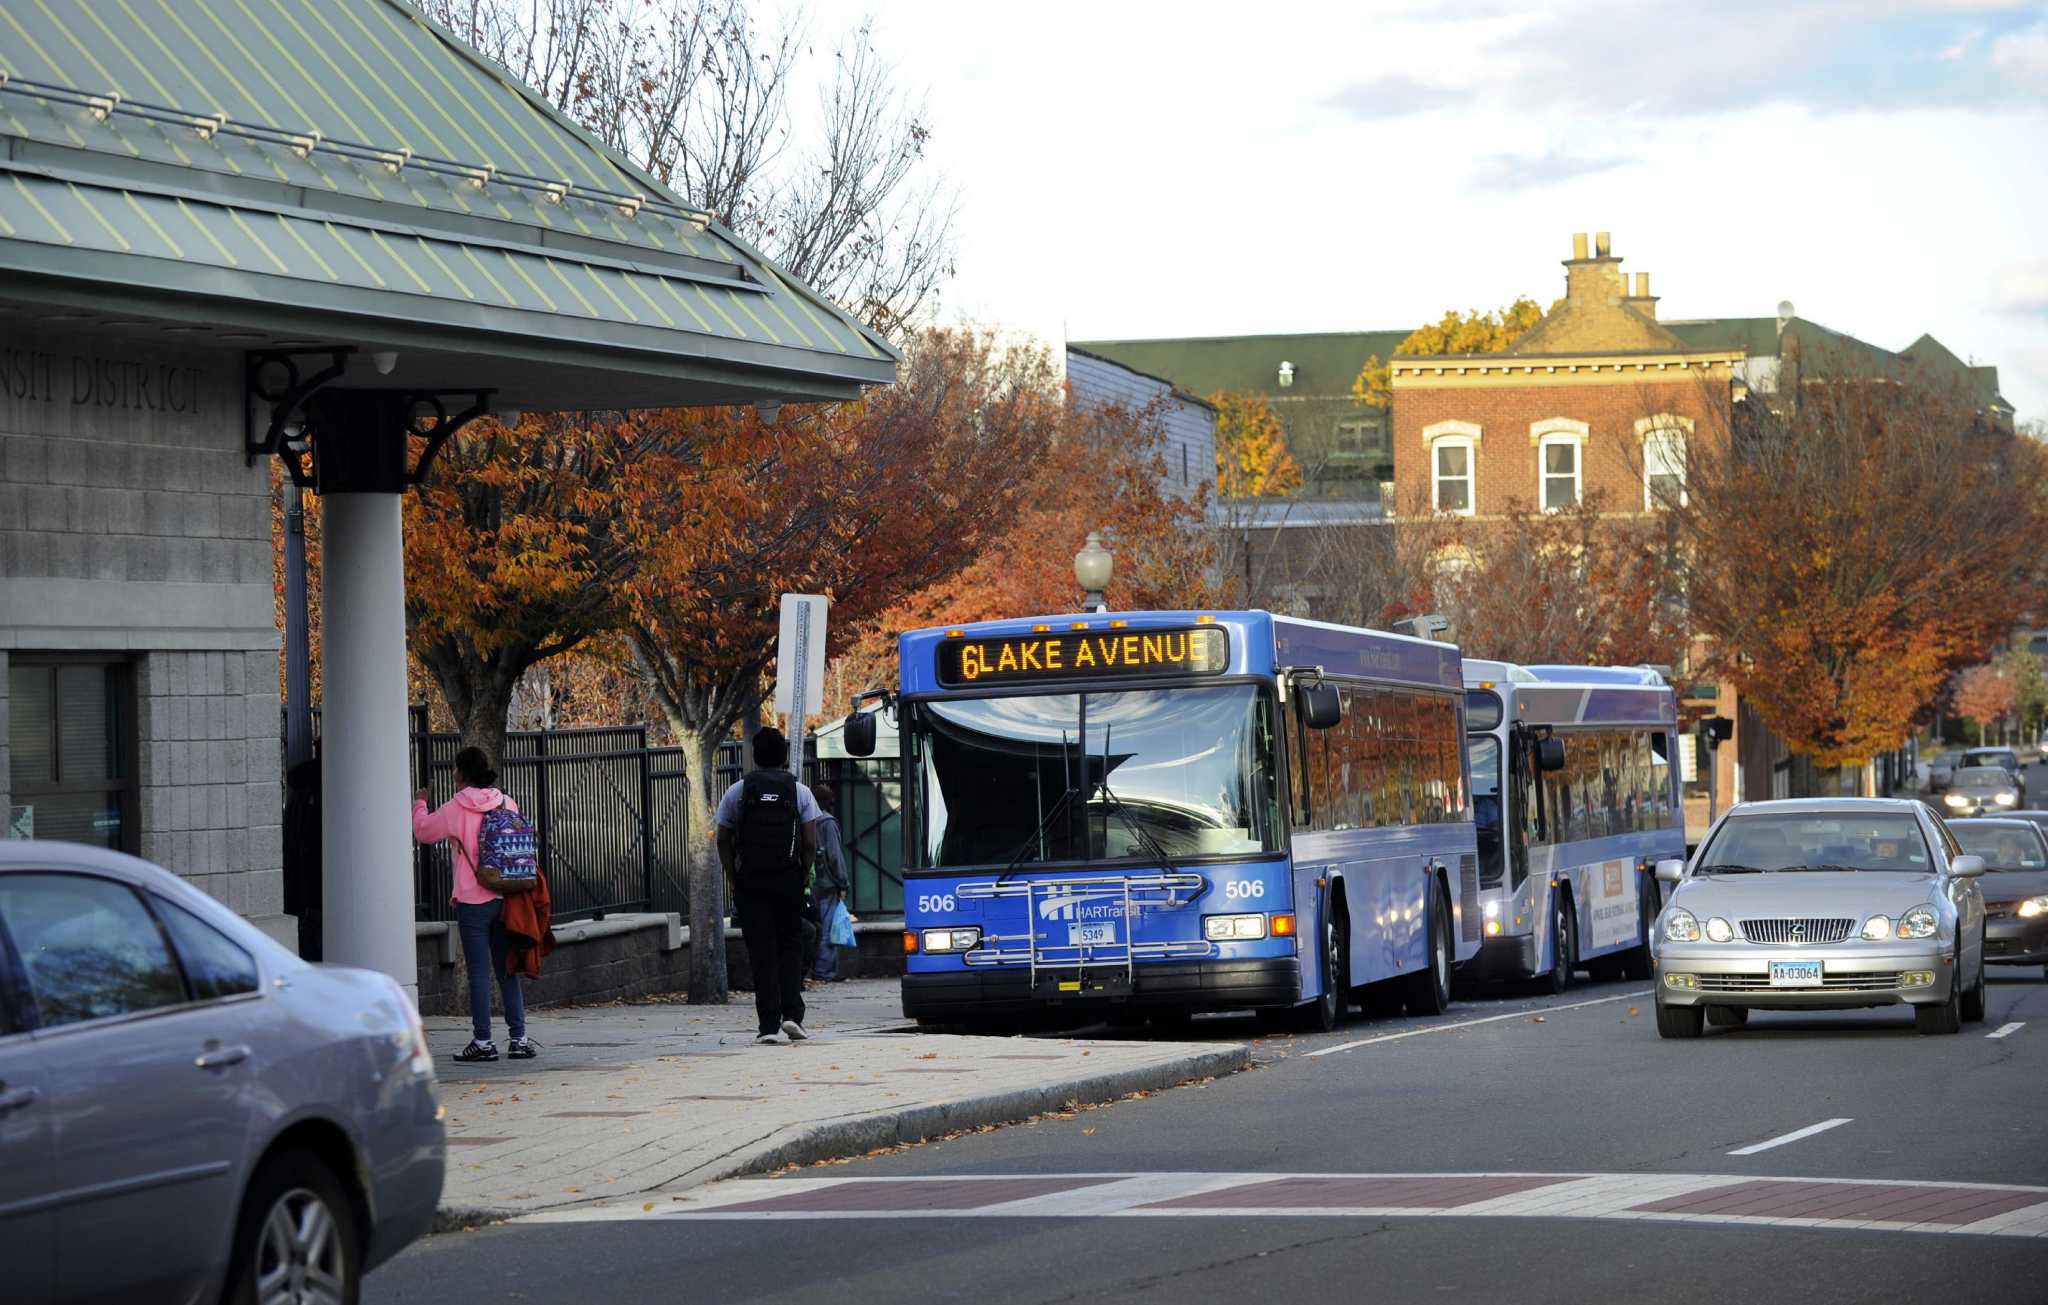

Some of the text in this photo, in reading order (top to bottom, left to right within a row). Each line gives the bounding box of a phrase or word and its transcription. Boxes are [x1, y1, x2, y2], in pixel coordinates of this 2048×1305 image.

[71, 355, 203, 415] DISTRICT
[1075, 632, 1208, 667] AVENUE
[1225, 879, 1265, 899] 506
[918, 894, 955, 913] 506
[1082, 929, 1104, 941] 5349
[1773, 967, 1819, 979] AA-03064
